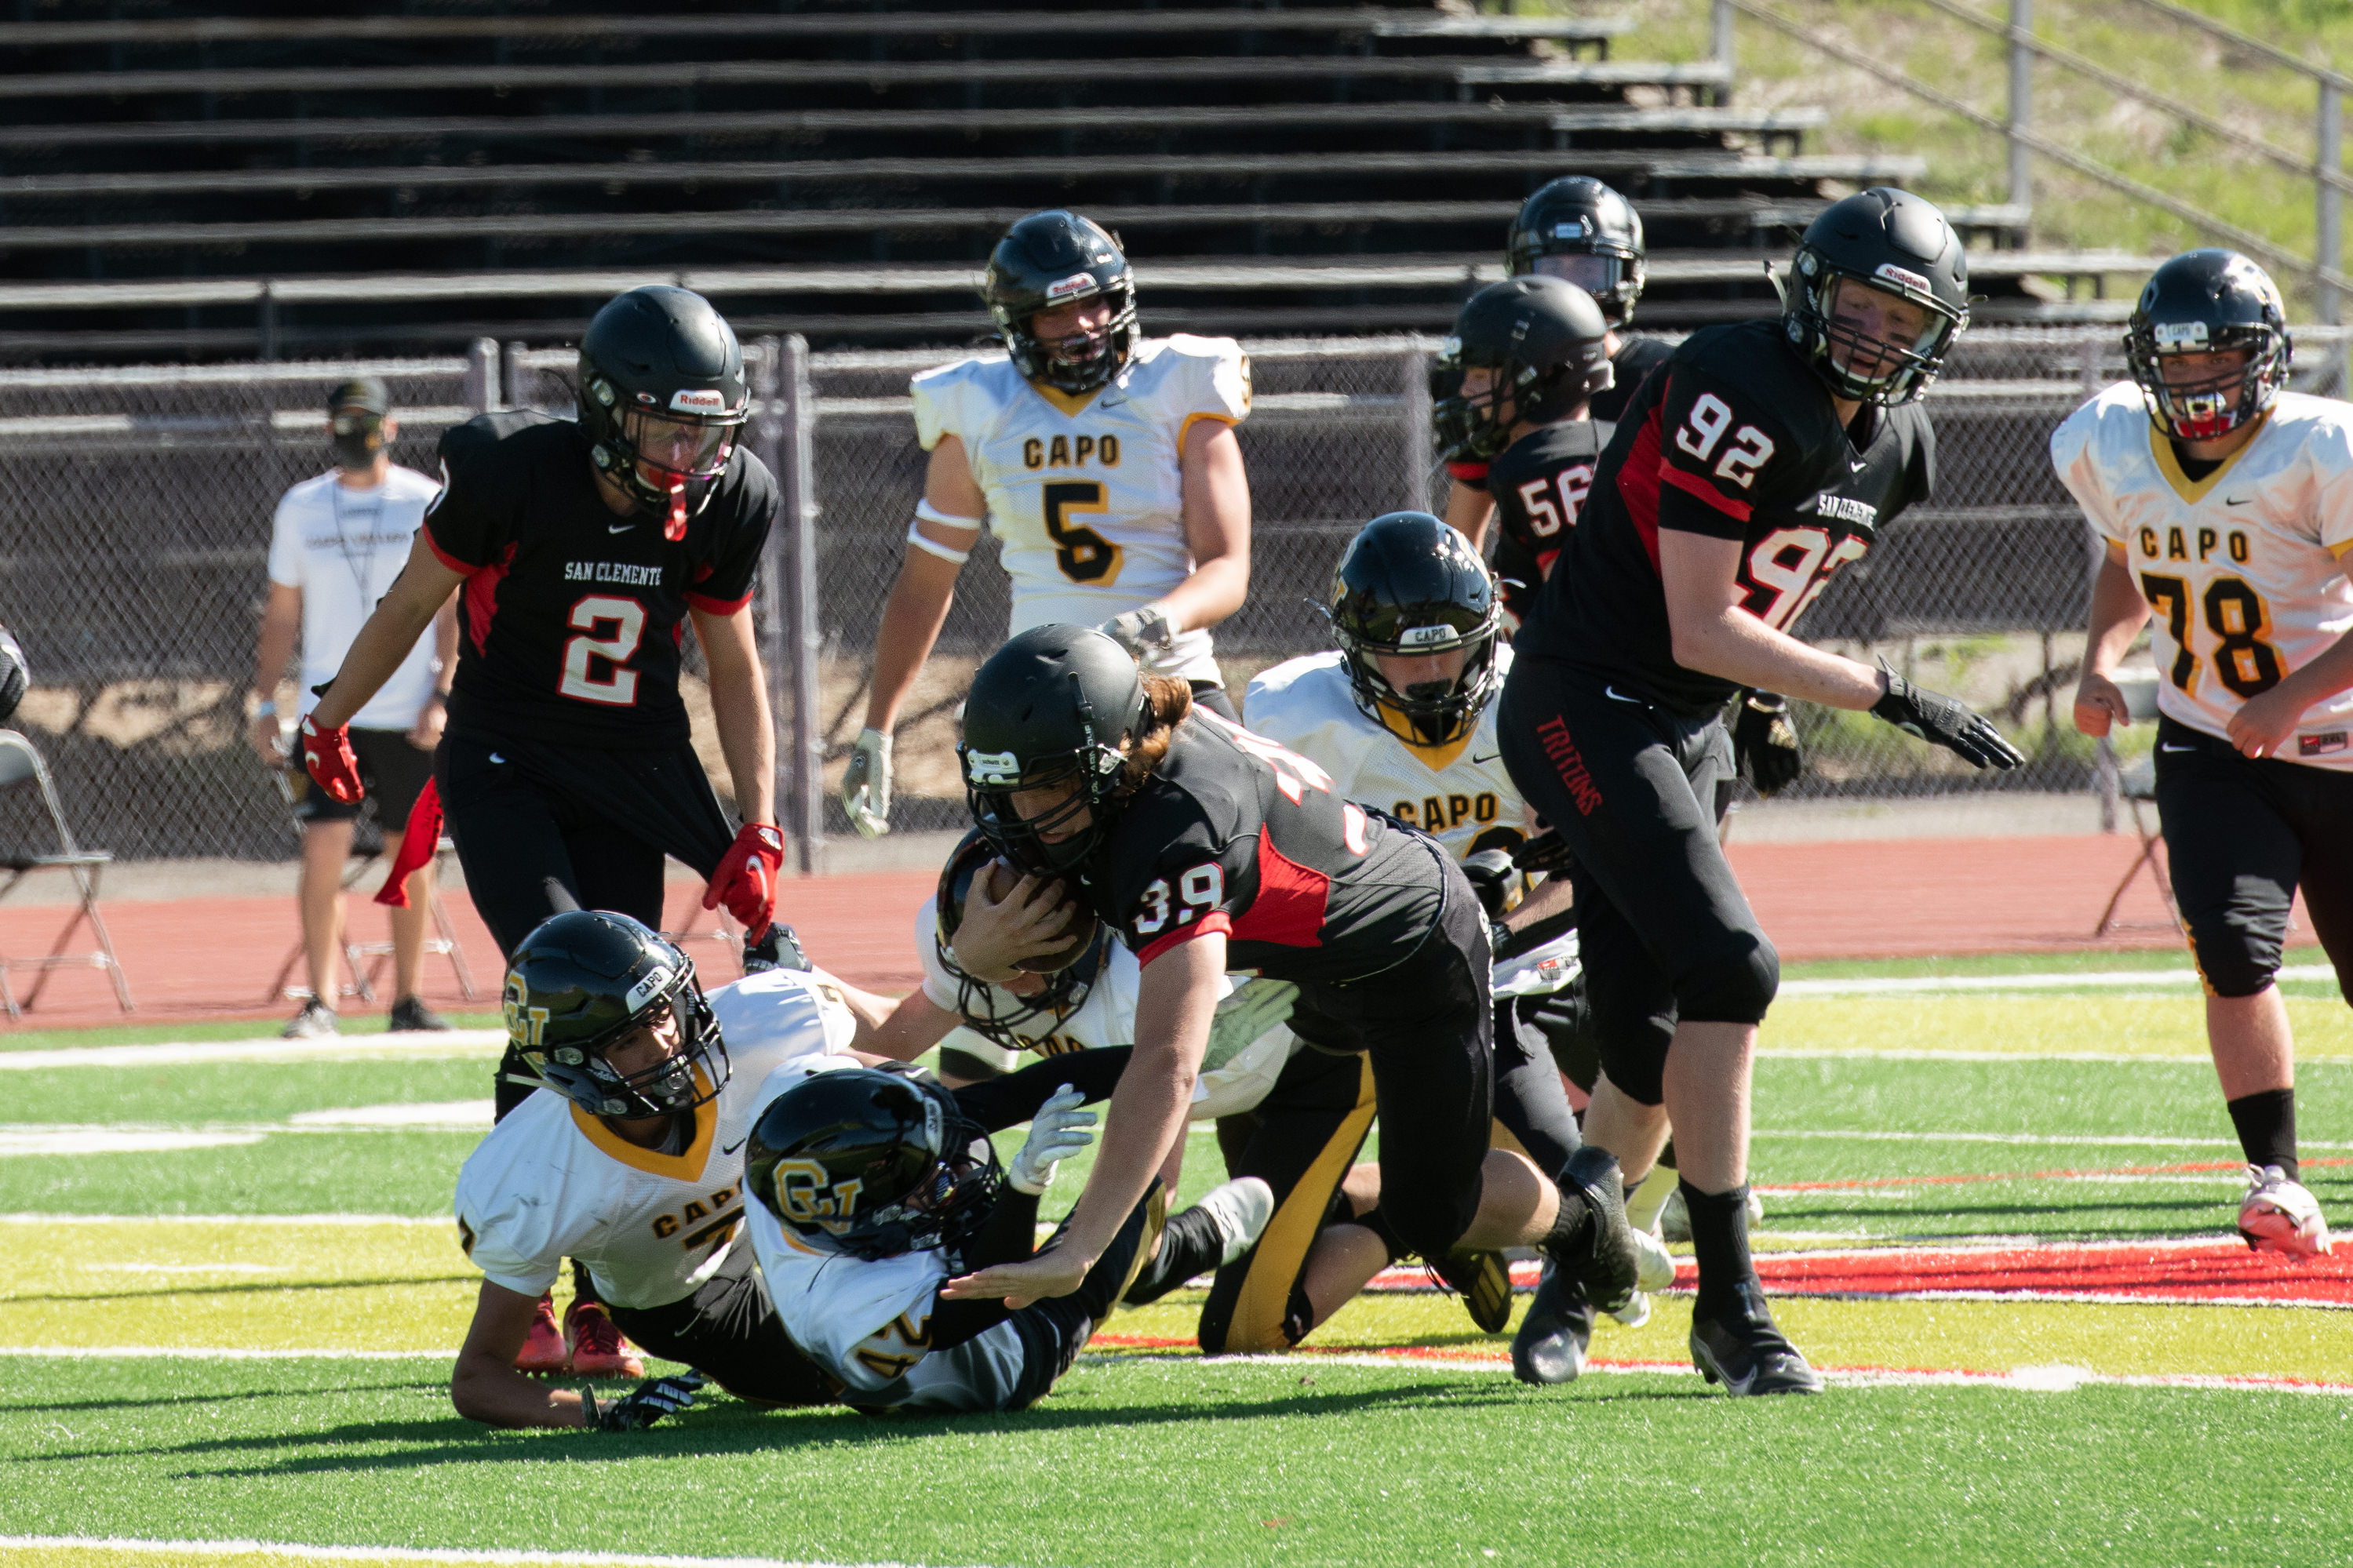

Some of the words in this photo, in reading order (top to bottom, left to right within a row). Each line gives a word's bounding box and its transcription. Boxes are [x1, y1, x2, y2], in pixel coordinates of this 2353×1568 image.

[1885, 266, 1928, 290] Riddell
[679, 394, 720, 406] Riddell
[1023, 434, 1122, 471] CAPO
[1675, 392, 1776, 489] 92
[1517, 464, 1594, 538] 56
[1041, 479, 1124, 588] 5
[2140, 525, 2251, 565] CAPO
[564, 561, 594, 580] SAN
[595, 562, 664, 587] CLEMENTE
[555, 593, 649, 706] 2
[1415, 628, 1446, 642] CAPO
[2139, 569, 2290, 701] 78
[1536, 714, 1603, 816] TRITONS
[1392, 791, 1499, 836] CAPO
[1131, 861, 1225, 935] 39
[636, 971, 662, 998] CAPO
[680, 1204, 745, 1260] 7
